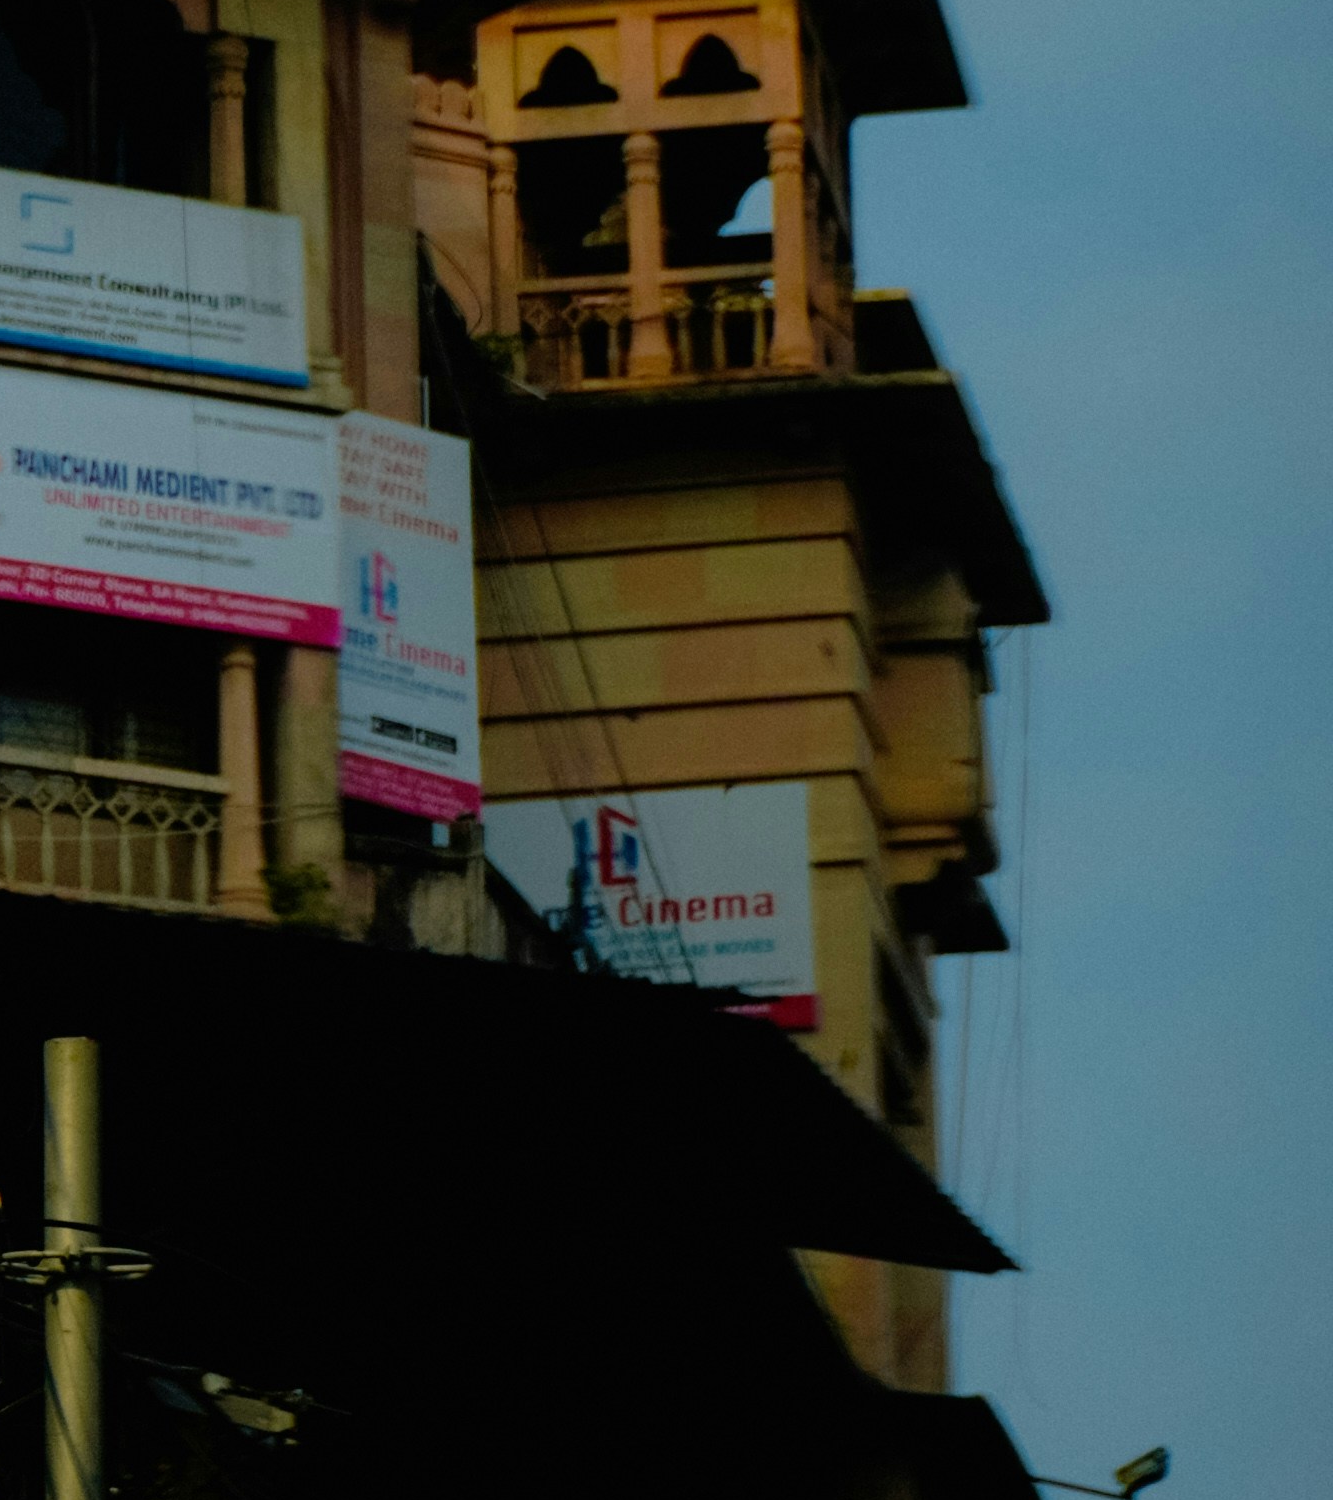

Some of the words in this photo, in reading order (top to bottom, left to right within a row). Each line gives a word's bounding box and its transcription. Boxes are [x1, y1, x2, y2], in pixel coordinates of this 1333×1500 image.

[97, 273, 220, 311] Consultancy
[12, 447, 129, 491] PANCHAMI
[136, 467, 228, 503] MEDIENT
[44, 488, 140, 518] UNLIMITED
[386, 632, 466, 678] Cinema
[619, 892, 774, 927] Cinema
